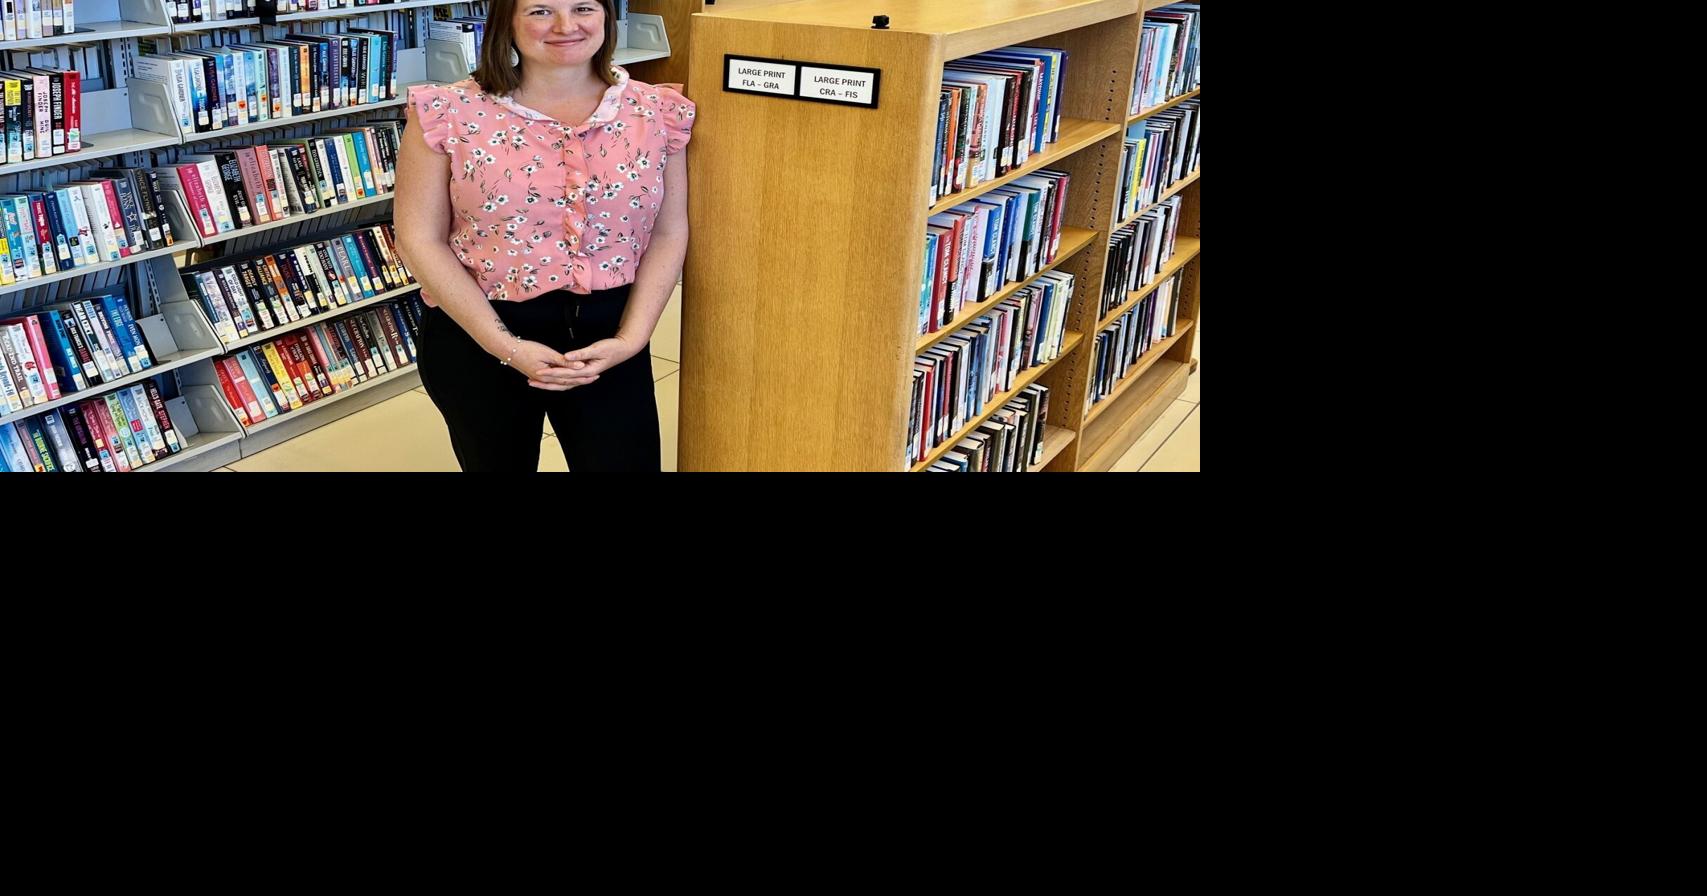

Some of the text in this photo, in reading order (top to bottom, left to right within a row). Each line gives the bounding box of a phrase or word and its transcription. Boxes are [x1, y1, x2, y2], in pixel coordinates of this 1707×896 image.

[738, 68, 786, 78] LARGE PRINT
[814, 76, 866, 87] LARGE PRINT
[819, 88, 836, 96] CRA
[51, 82, 62, 119] JOSEPH FINDER
[336, 245, 350, 270] PEARL
[127, 323, 137, 335] EVEN
[8, 351, 17, 365] END
[12, 364, 23, 382] TRAIL
[157, 409, 170, 430] STEPHEN
